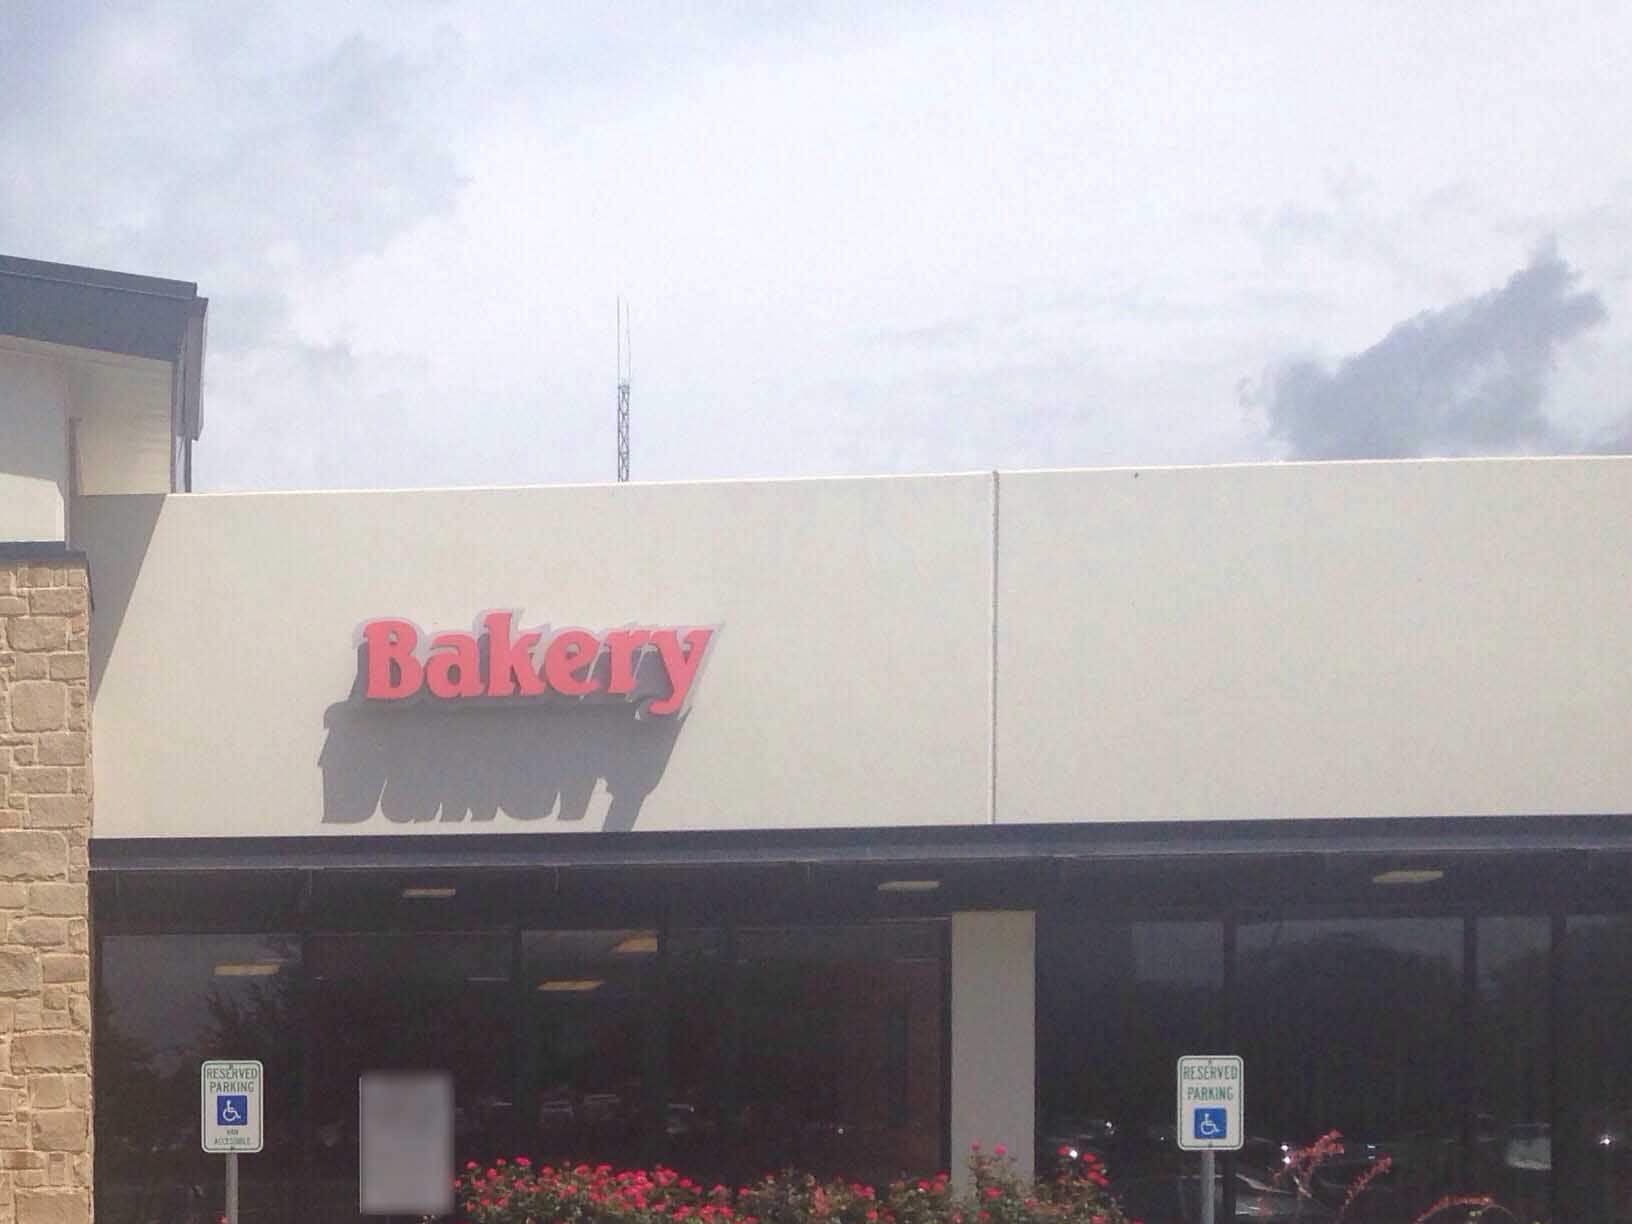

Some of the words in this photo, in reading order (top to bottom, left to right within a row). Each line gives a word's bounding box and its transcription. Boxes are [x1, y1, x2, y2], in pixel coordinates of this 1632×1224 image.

[363, 609, 714, 715] Bakery
[207, 1068, 258, 1079] RESERVED
[1183, 1065, 1238, 1080] RESERVED
[209, 1081, 255, 1093] PARKING
[1187, 1086, 1234, 1100] PARKING
